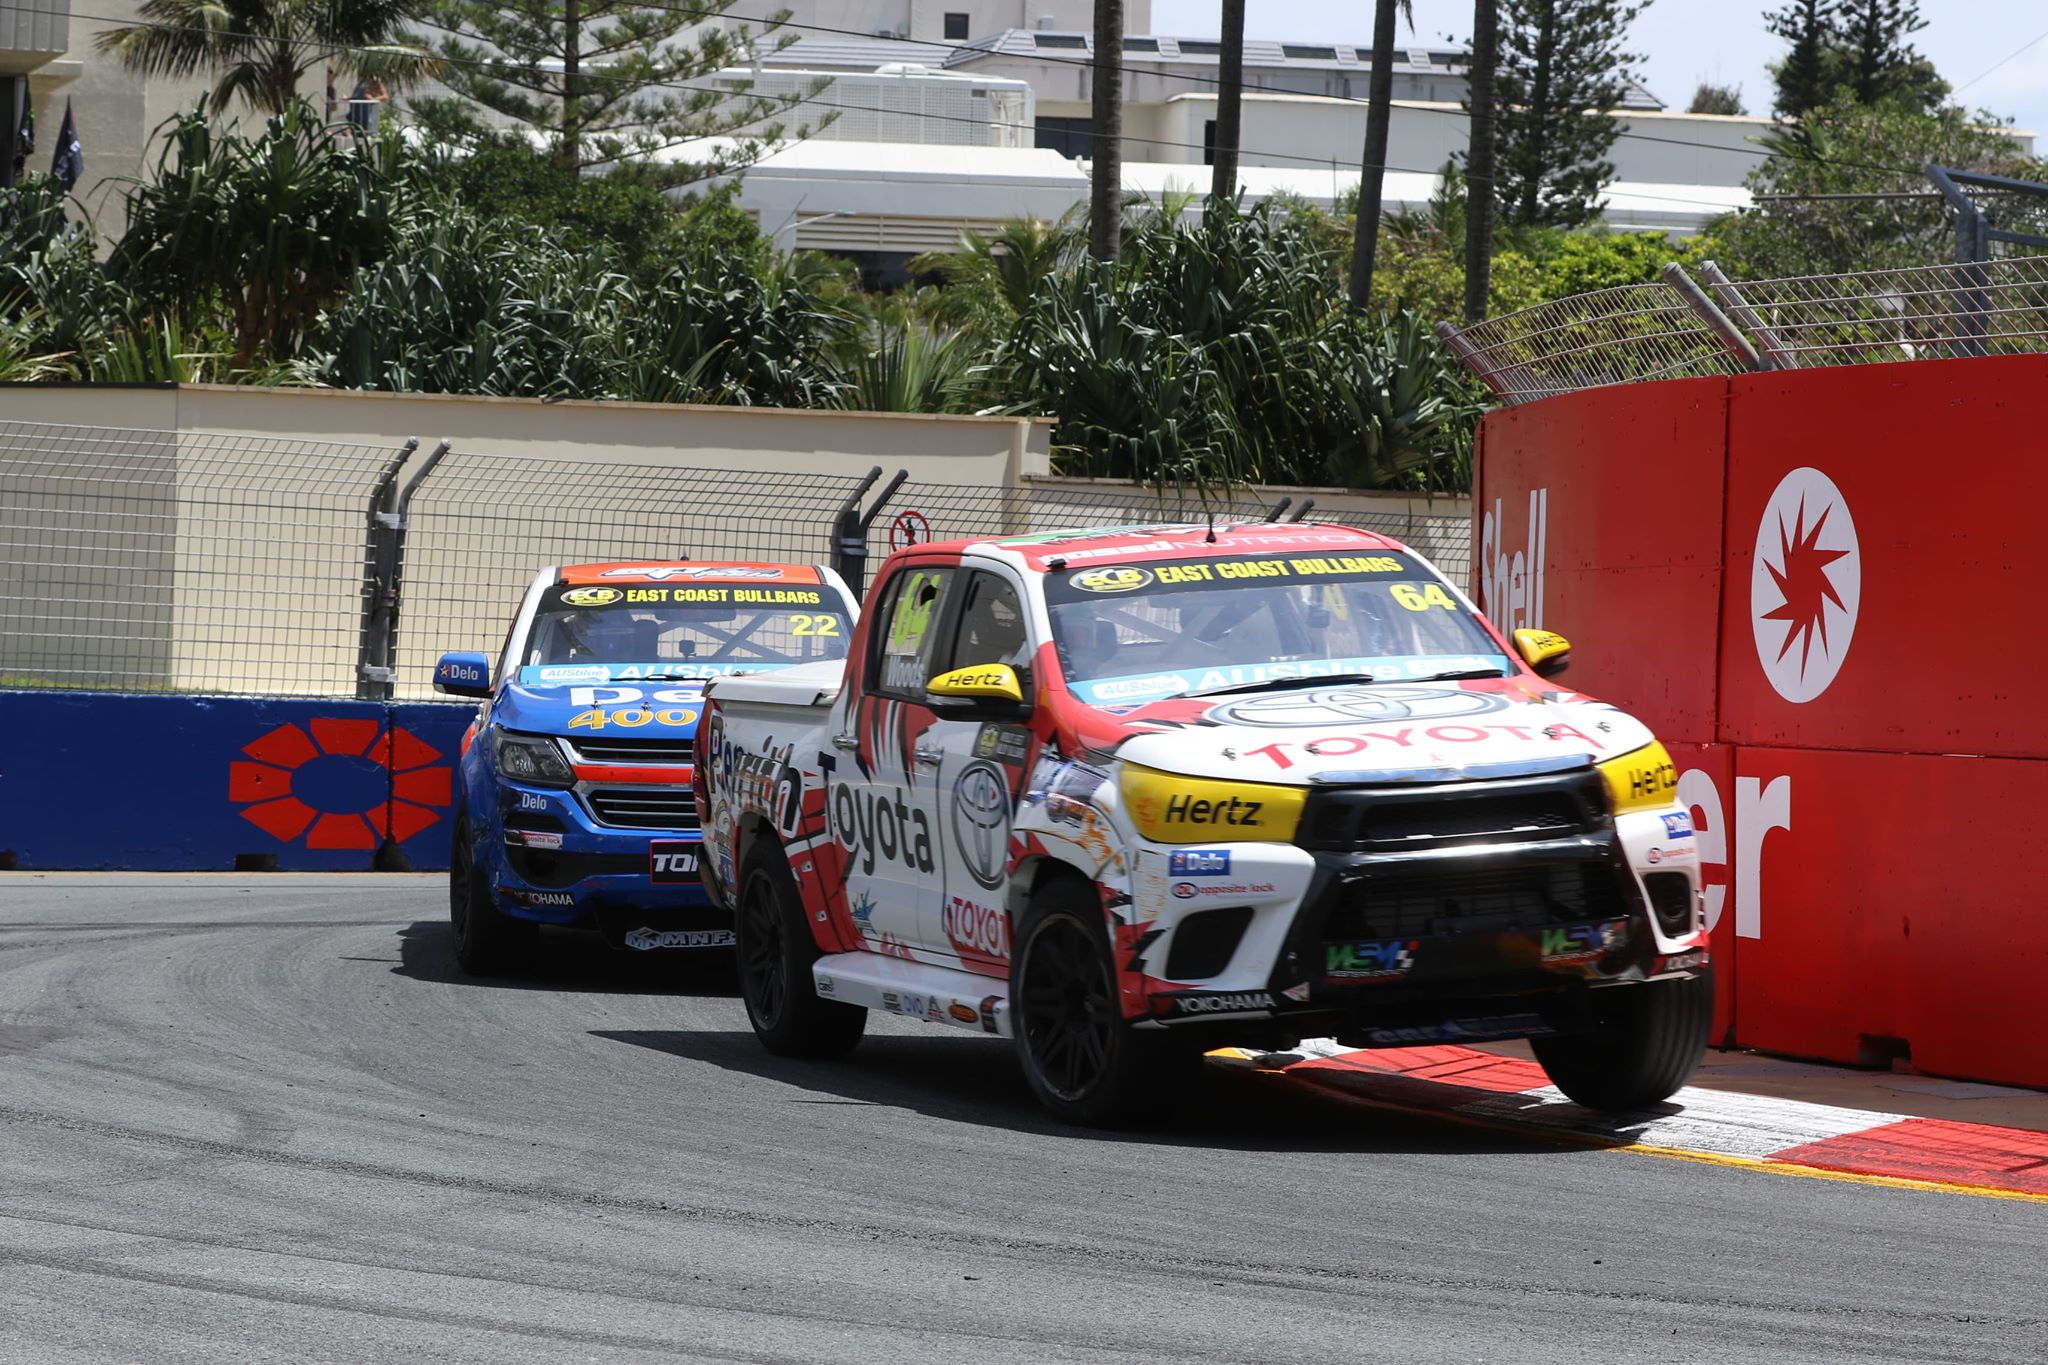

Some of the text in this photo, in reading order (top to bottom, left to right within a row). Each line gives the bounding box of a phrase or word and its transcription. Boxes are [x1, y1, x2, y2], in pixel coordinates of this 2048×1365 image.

[1153, 564, 1213, 583] EAST
[1215, 560, 1291, 579] COAST
[1289, 557, 1404, 575] BULLBARS
[1482, 488, 1548, 632] Shell
[626, 589, 669, 602] EAST
[673, 589, 730, 602] COAST
[734, 589, 821, 604] BULLBARS
[1389, 583, 1457, 611] 64
[790, 614, 839, 636] 22
[451, 664, 479, 681] Delo
[546, 669, 604, 678] AUSblue
[946, 672, 1004, 687] Hertz
[570, 687, 706, 706] De
[568, 709, 698, 730] 400
[1244, 723, 1607, 769] TOYOTA
[522, 793, 547, 810] Delo
[1165, 794, 1264, 826] Hertz
[817, 751, 935, 876] Toyota
[1187, 852, 1225, 871] Delo
[952, 896, 1010, 955] TOYOT
[1176, 993, 1277, 1013] YOKOHAMA
